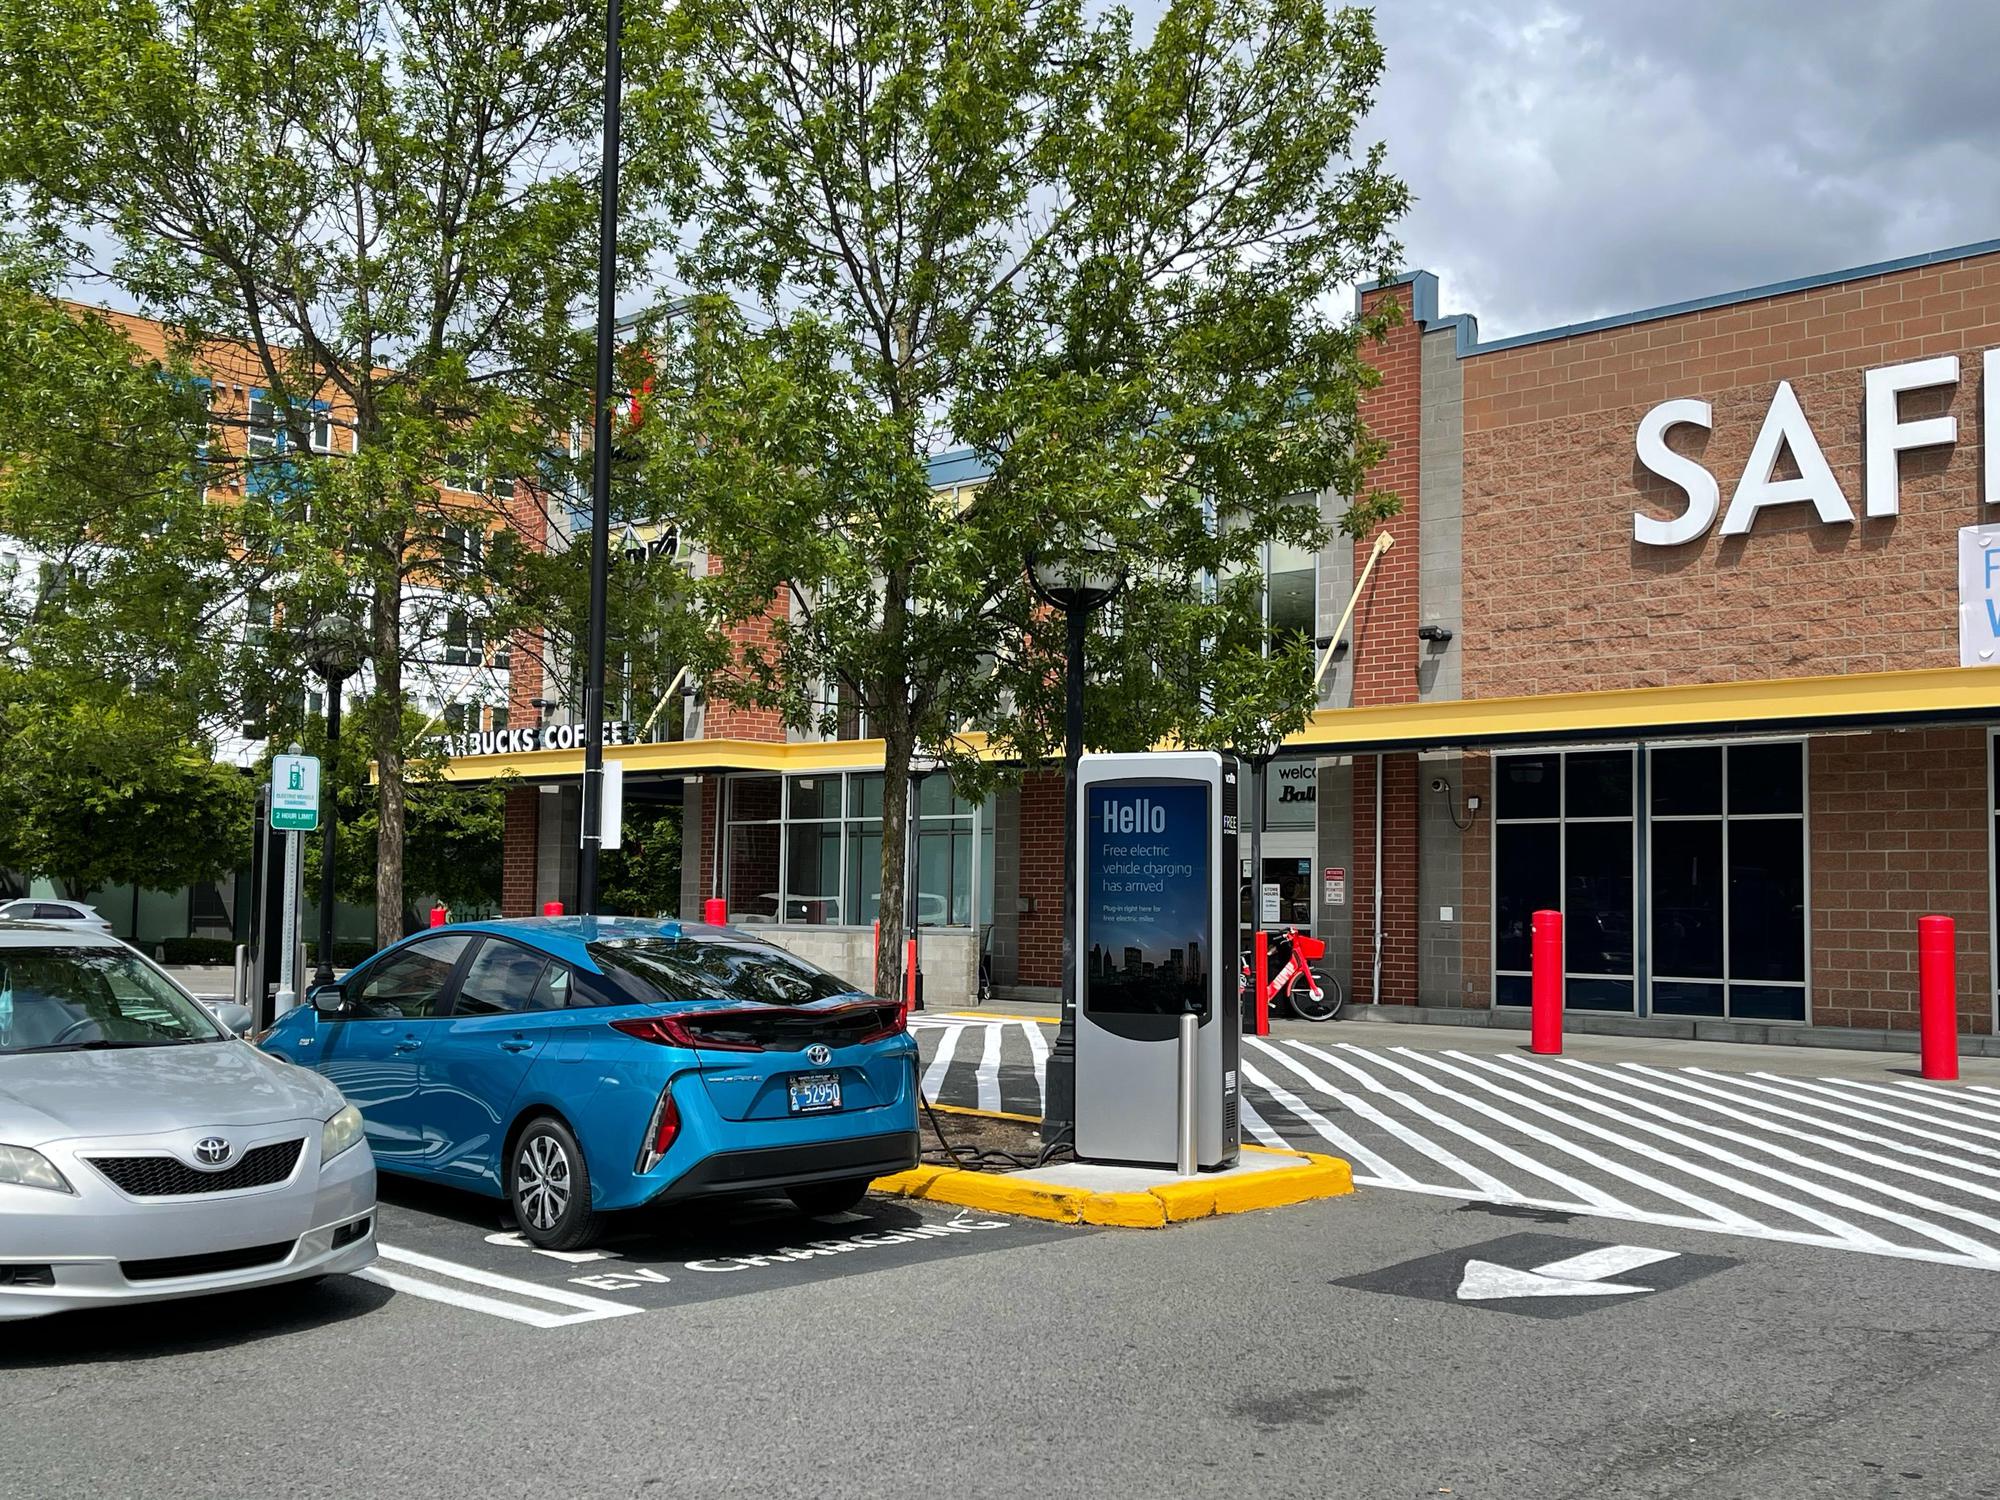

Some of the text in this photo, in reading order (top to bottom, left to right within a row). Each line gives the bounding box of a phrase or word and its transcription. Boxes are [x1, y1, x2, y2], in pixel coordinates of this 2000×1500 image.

[544, 721, 622, 749] COFEE
[281, 812, 297, 820] HOUR
[298, 813, 314, 821] LIMIT
[1103, 798, 1165, 833] Hello
[1224, 815, 1237, 829] FREE
[1103, 843, 1170, 856] Free electric
[1103, 861, 1192, 877] vehicle charging
[1103, 879, 1164, 892] has arrived
[1272, 961, 1296, 991] JUMP
[804, 1083, 840, 1104] 52950
[567, 1218, 1011, 1291] EV CHARGING
